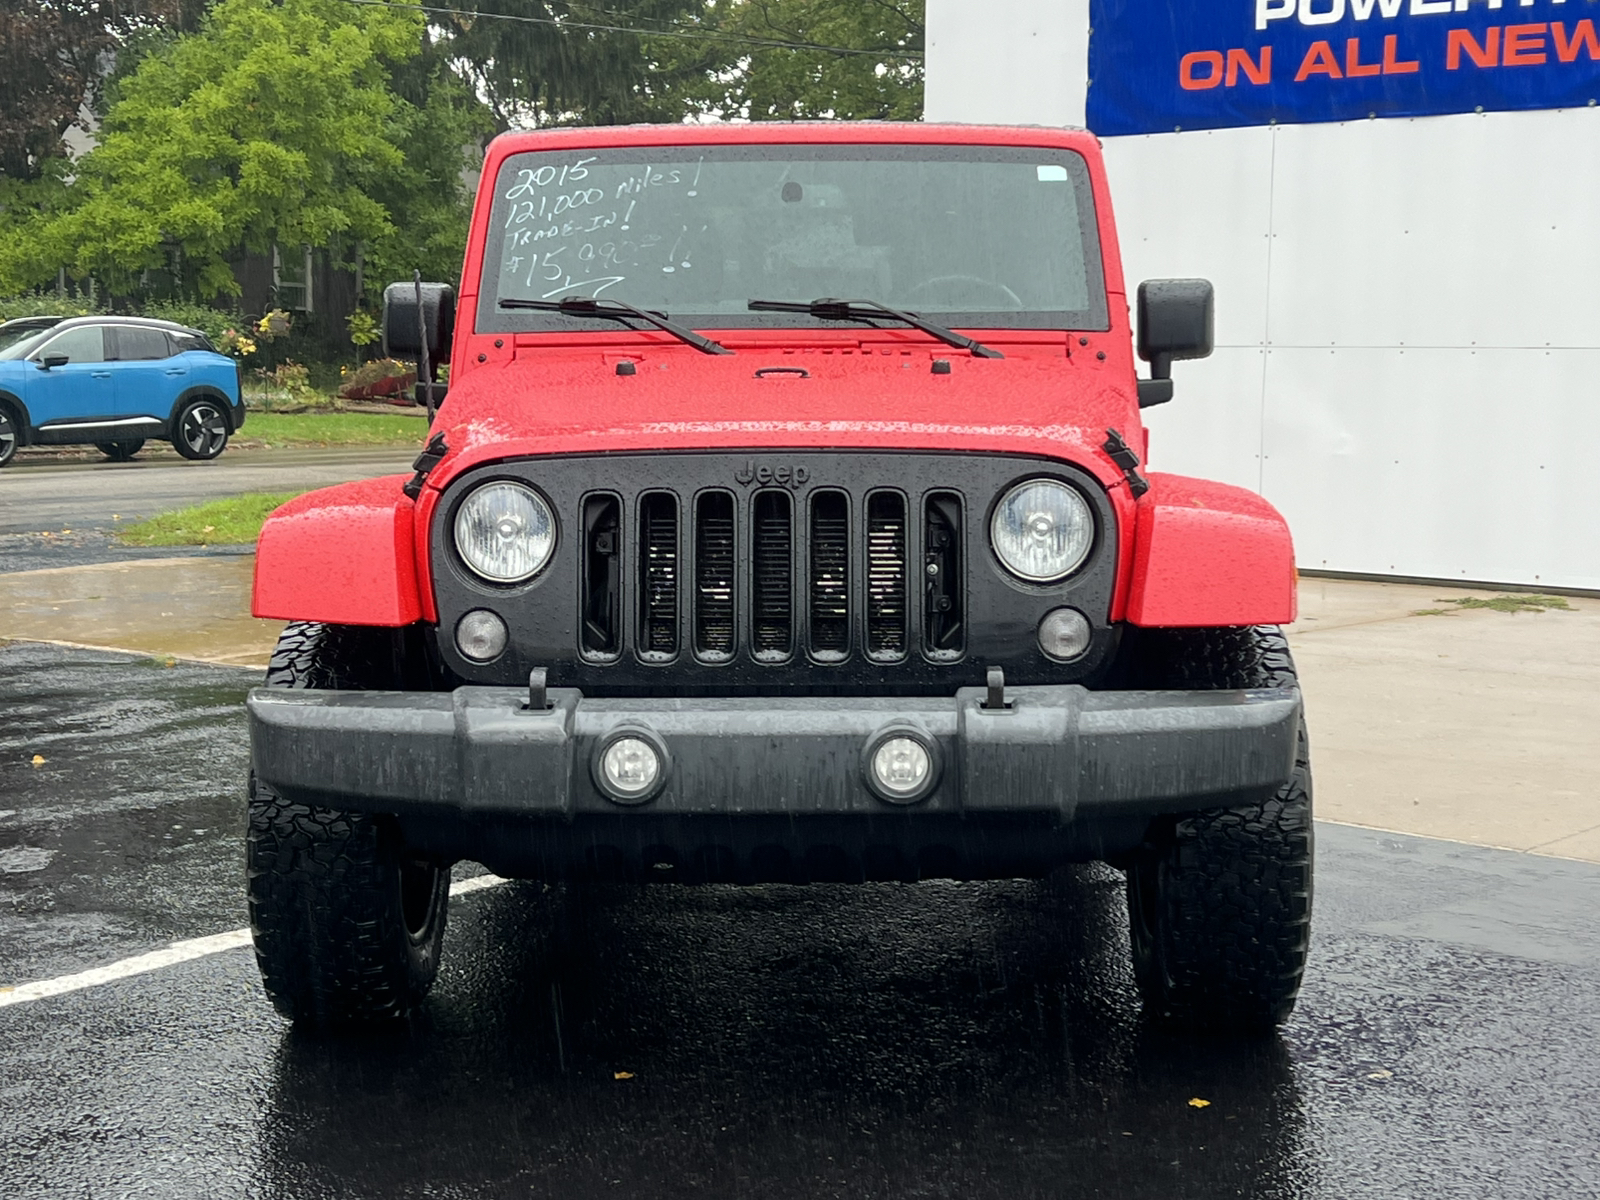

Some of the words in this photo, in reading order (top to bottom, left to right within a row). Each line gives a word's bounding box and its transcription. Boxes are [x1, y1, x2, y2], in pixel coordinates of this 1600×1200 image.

[1179, 46, 1272, 91] ON
[1294, 35, 1419, 82] ALL
[1446, 18, 1600, 71] NEW
[505, 156, 597, 200] 2015
[505, 187, 604, 229] 121,000
[734, 461, 811, 490] Jeep
